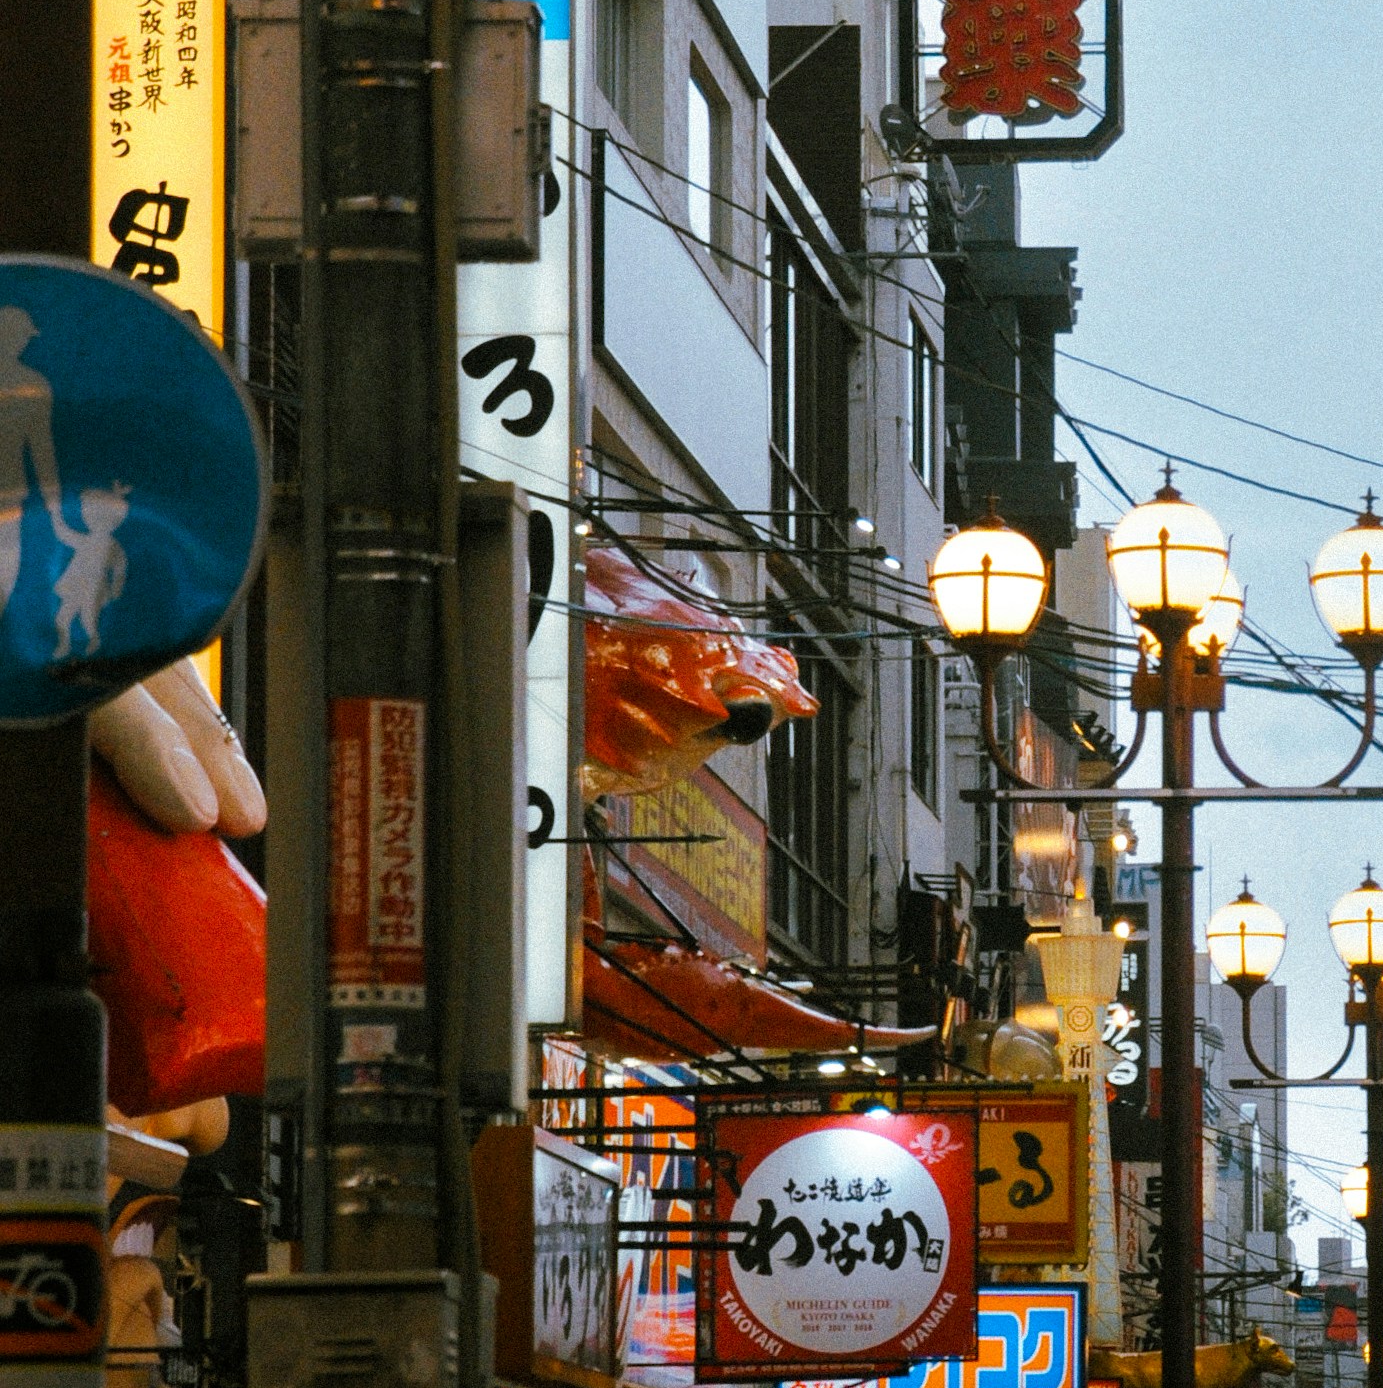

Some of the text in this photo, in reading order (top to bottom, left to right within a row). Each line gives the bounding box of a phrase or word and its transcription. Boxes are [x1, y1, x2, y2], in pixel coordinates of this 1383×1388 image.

[107, 37, 134, 158] 元祖串かつ
[108, 181, 192, 289] 串
[783, 1177, 892, 1204] たこ焼道楽
[735, 1198, 928, 1276] わなか
[719, 1290, 784, 1357] TAKOYAKI
[785, 1298, 893, 1311] MICHELIN GUIDE
[801, 1311, 875, 1322] KYOTO OSAKA
[900, 1290, 959, 1352] WANAKA
